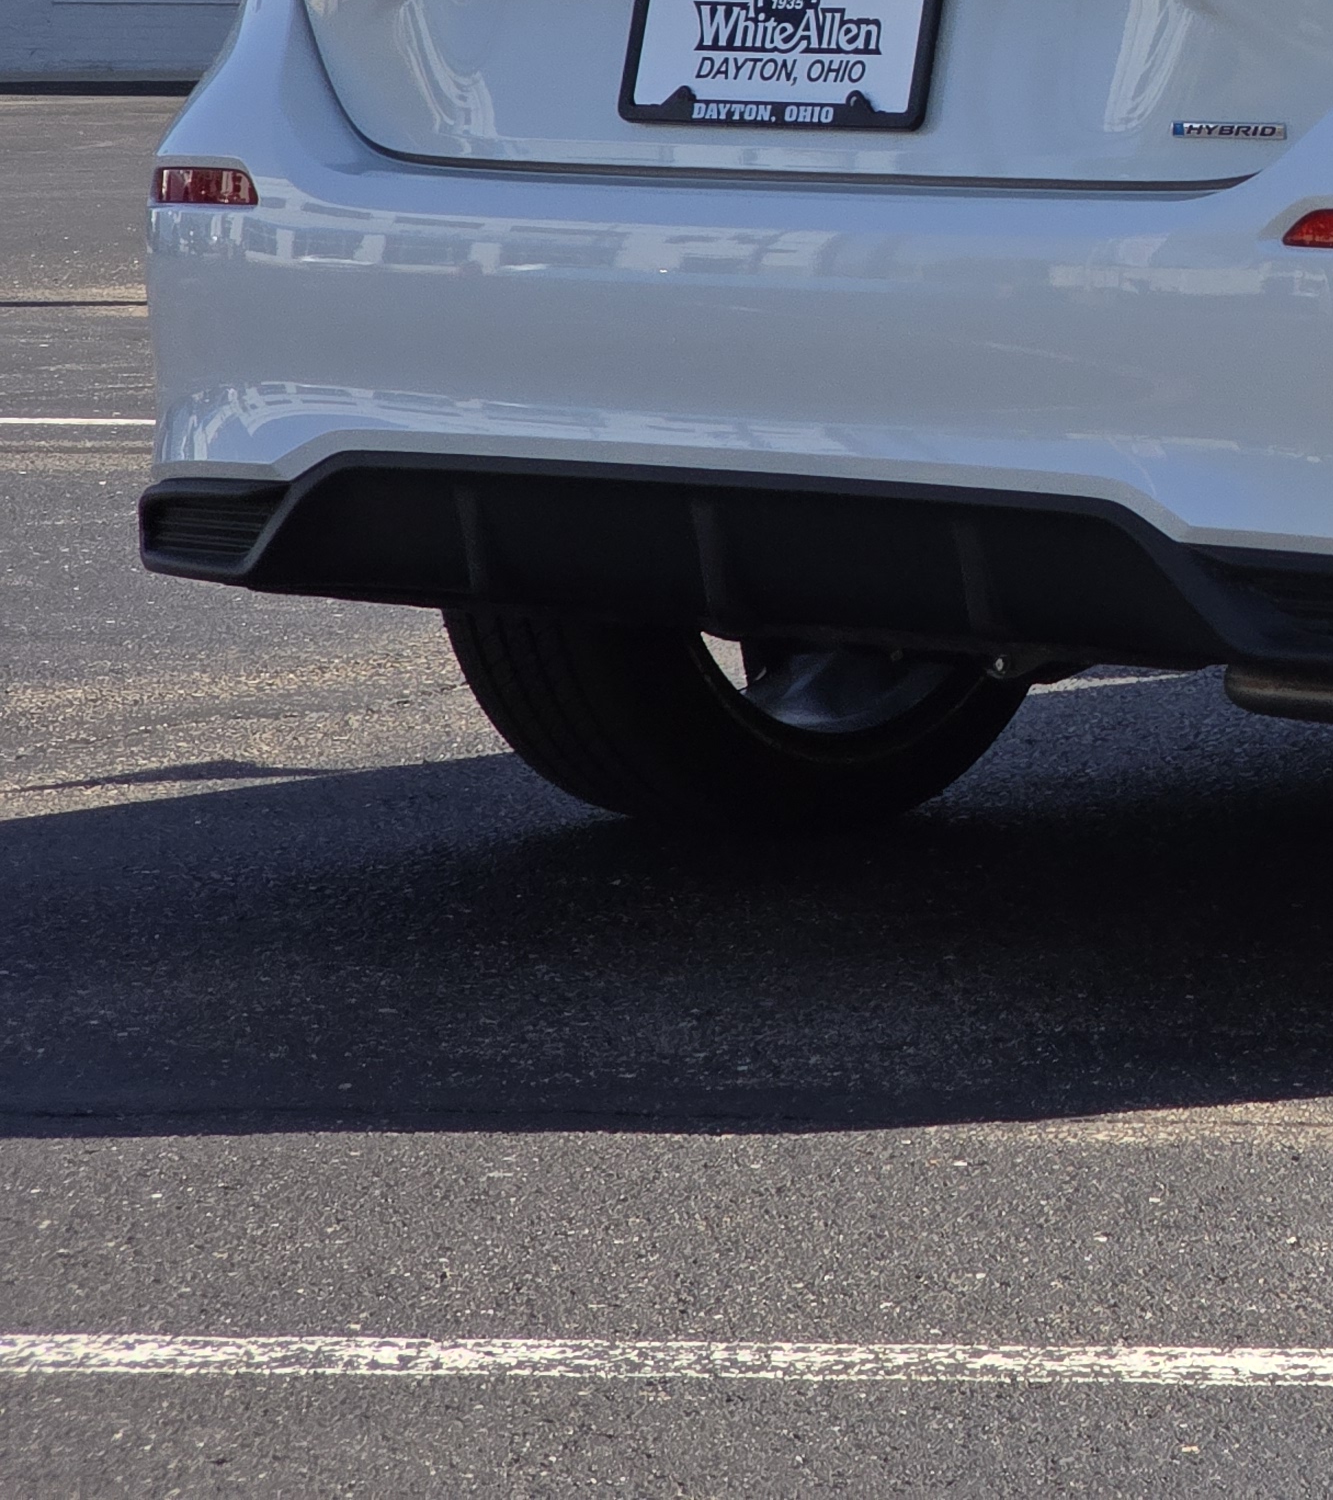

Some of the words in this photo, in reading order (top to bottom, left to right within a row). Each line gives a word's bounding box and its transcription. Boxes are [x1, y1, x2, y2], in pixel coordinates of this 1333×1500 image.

[694, 56, 799, 86] DAYTON,
[806, 59, 867, 84] OHIO
[783, 104, 834, 124] OHIO
[1186, 123, 1277, 137] HYBRID
